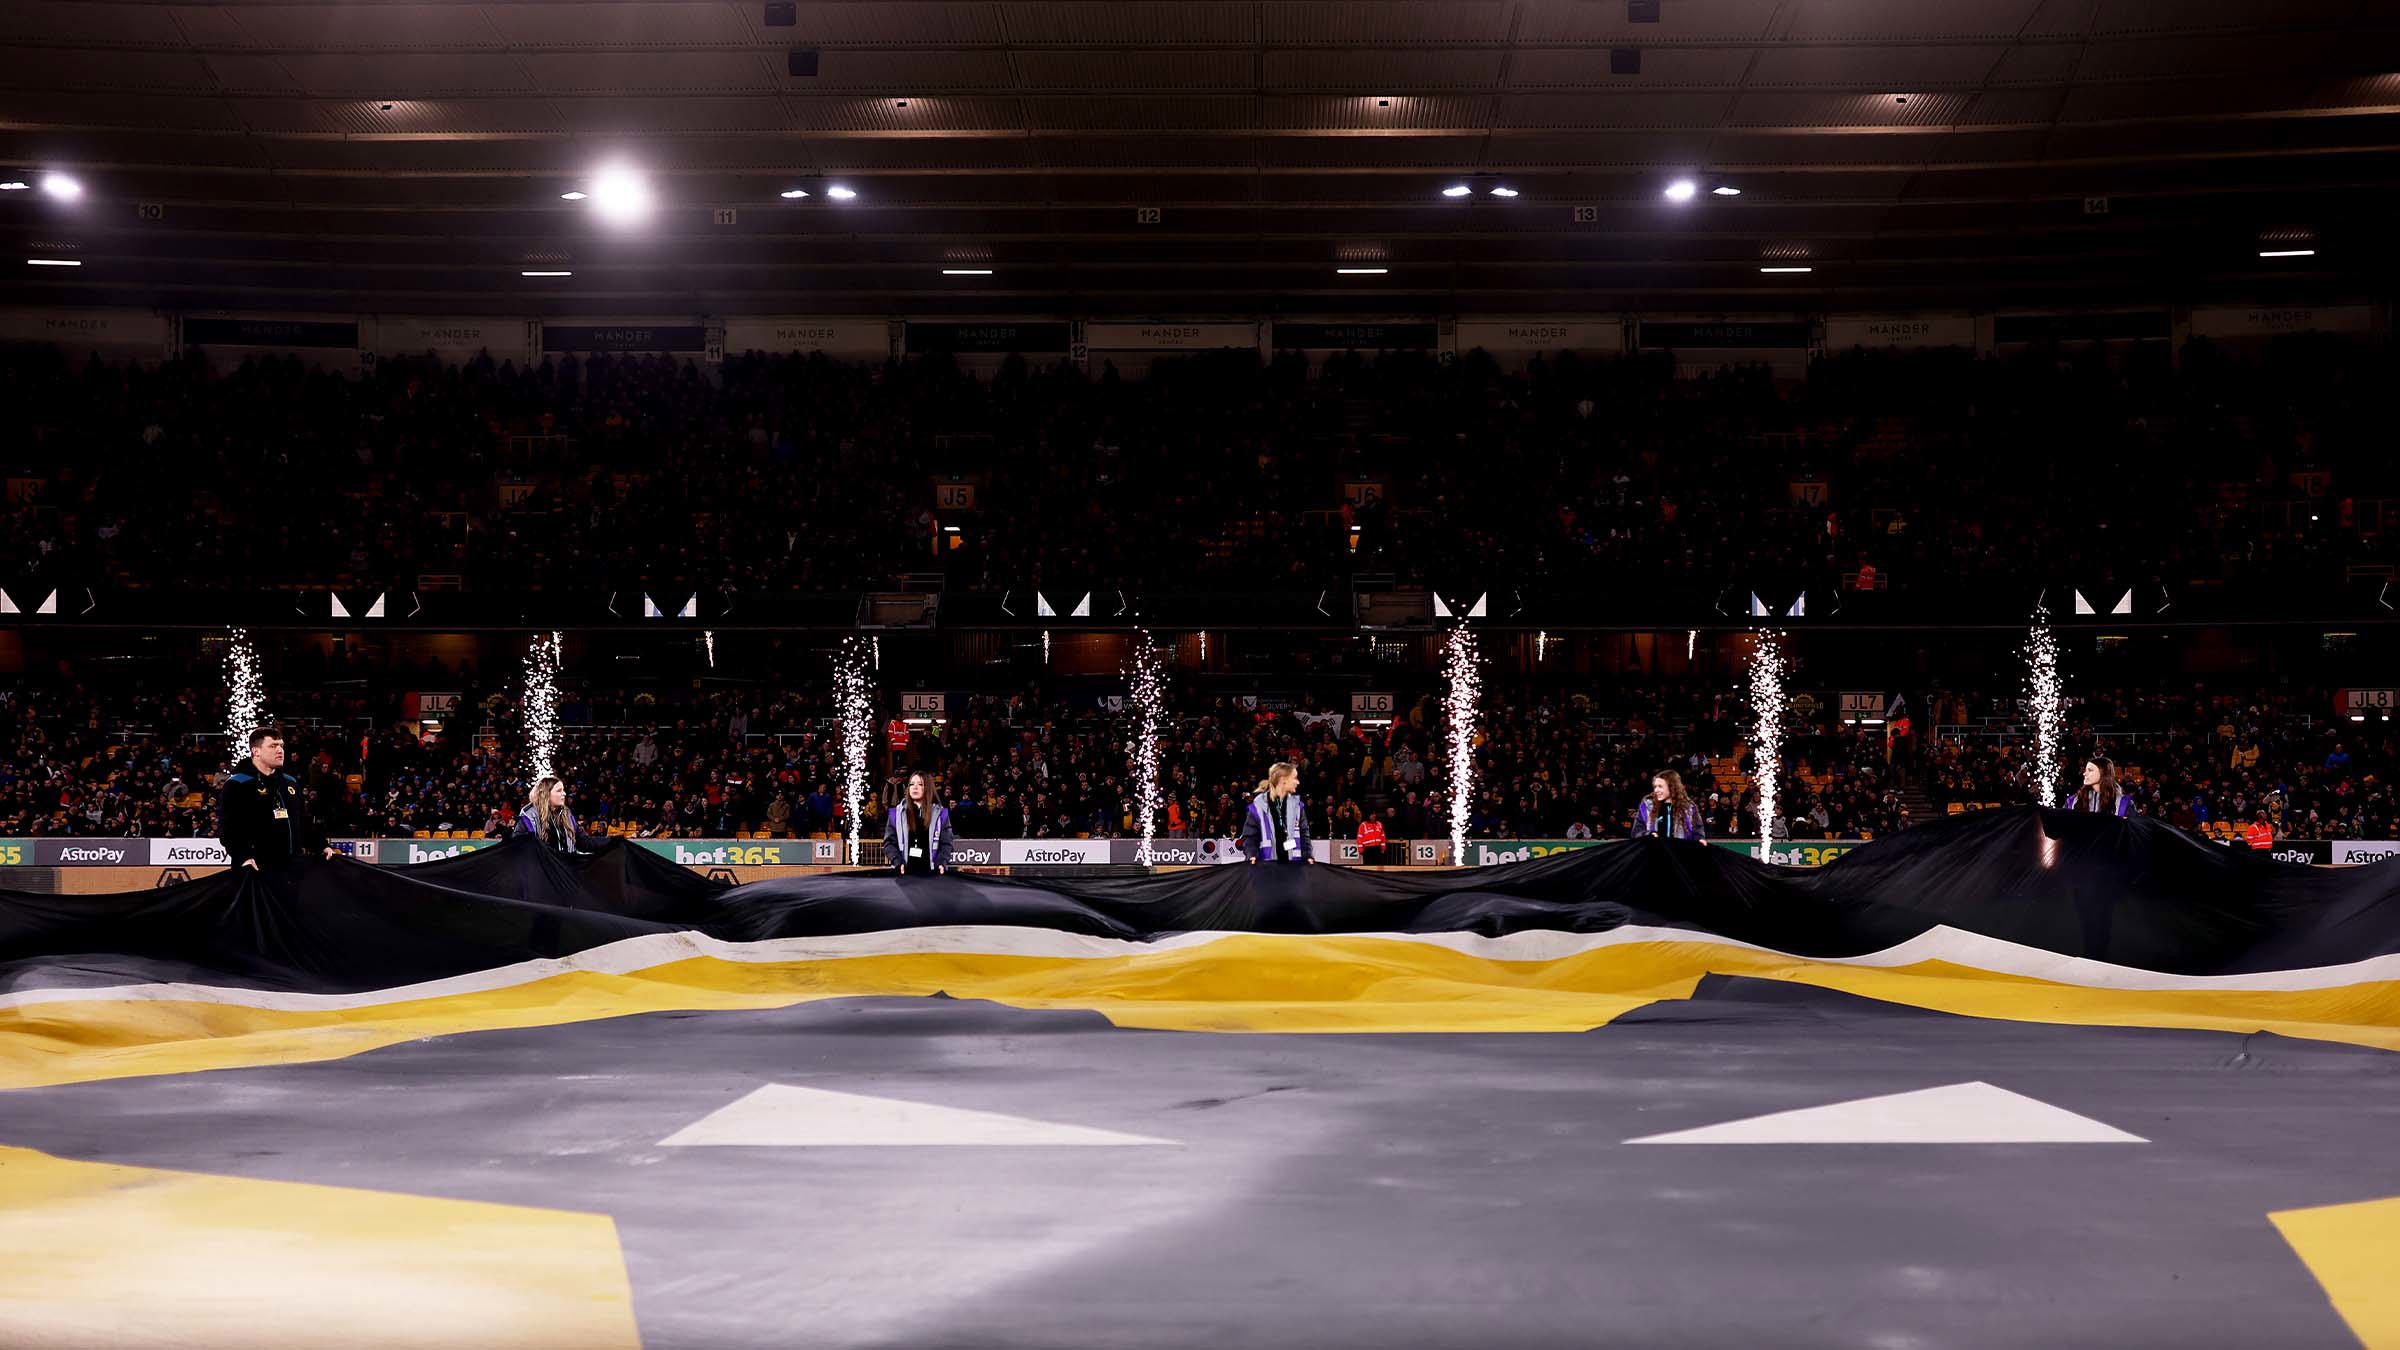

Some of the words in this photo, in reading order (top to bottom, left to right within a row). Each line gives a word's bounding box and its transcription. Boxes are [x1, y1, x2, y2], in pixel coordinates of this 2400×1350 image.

[141, 205, 160, 219] 10
[717, 211, 734, 224] 11
[1139, 208, 1159, 222] 12
[1576, 207, 1595, 221] 13
[776, 329, 834, 339] MANDER
[1142, 328, 1199, 337] MANDER
[1508, 328, 1567, 337] MANDER
[1869, 324, 1929, 334] MANDER
[360, 353, 374, 364] 10
[1072, 346, 1086, 359] 12
[944, 488, 967, 506] J5
[1352, 487, 1376, 505] J6
[426, 697, 457, 710] JL4
[908, 696, 939, 710] JL5
[1358, 696, 1388, 710] JL6
[1849, 696, 1877, 709] JL7
[2355, 692, 2388, 707] JL8
[59, 847, 125, 863] AstroPay
[167, 847, 228, 863] AstroPay
[359, 844, 371, 855] 11
[675, 845, 780, 864] bet365
[819, 845, 832, 856] 11
[950, 849, 991, 864] roPay
[1025, 849, 1085, 864] AstroPay
[1134, 848, 1196, 864] AtroPay
[1343, 847, 1358, 857] 12
[1418, 847, 1434, 858] 13
[2271, 850, 2315, 865] roPay
[2344, 850, 2400, 864] AstroP
